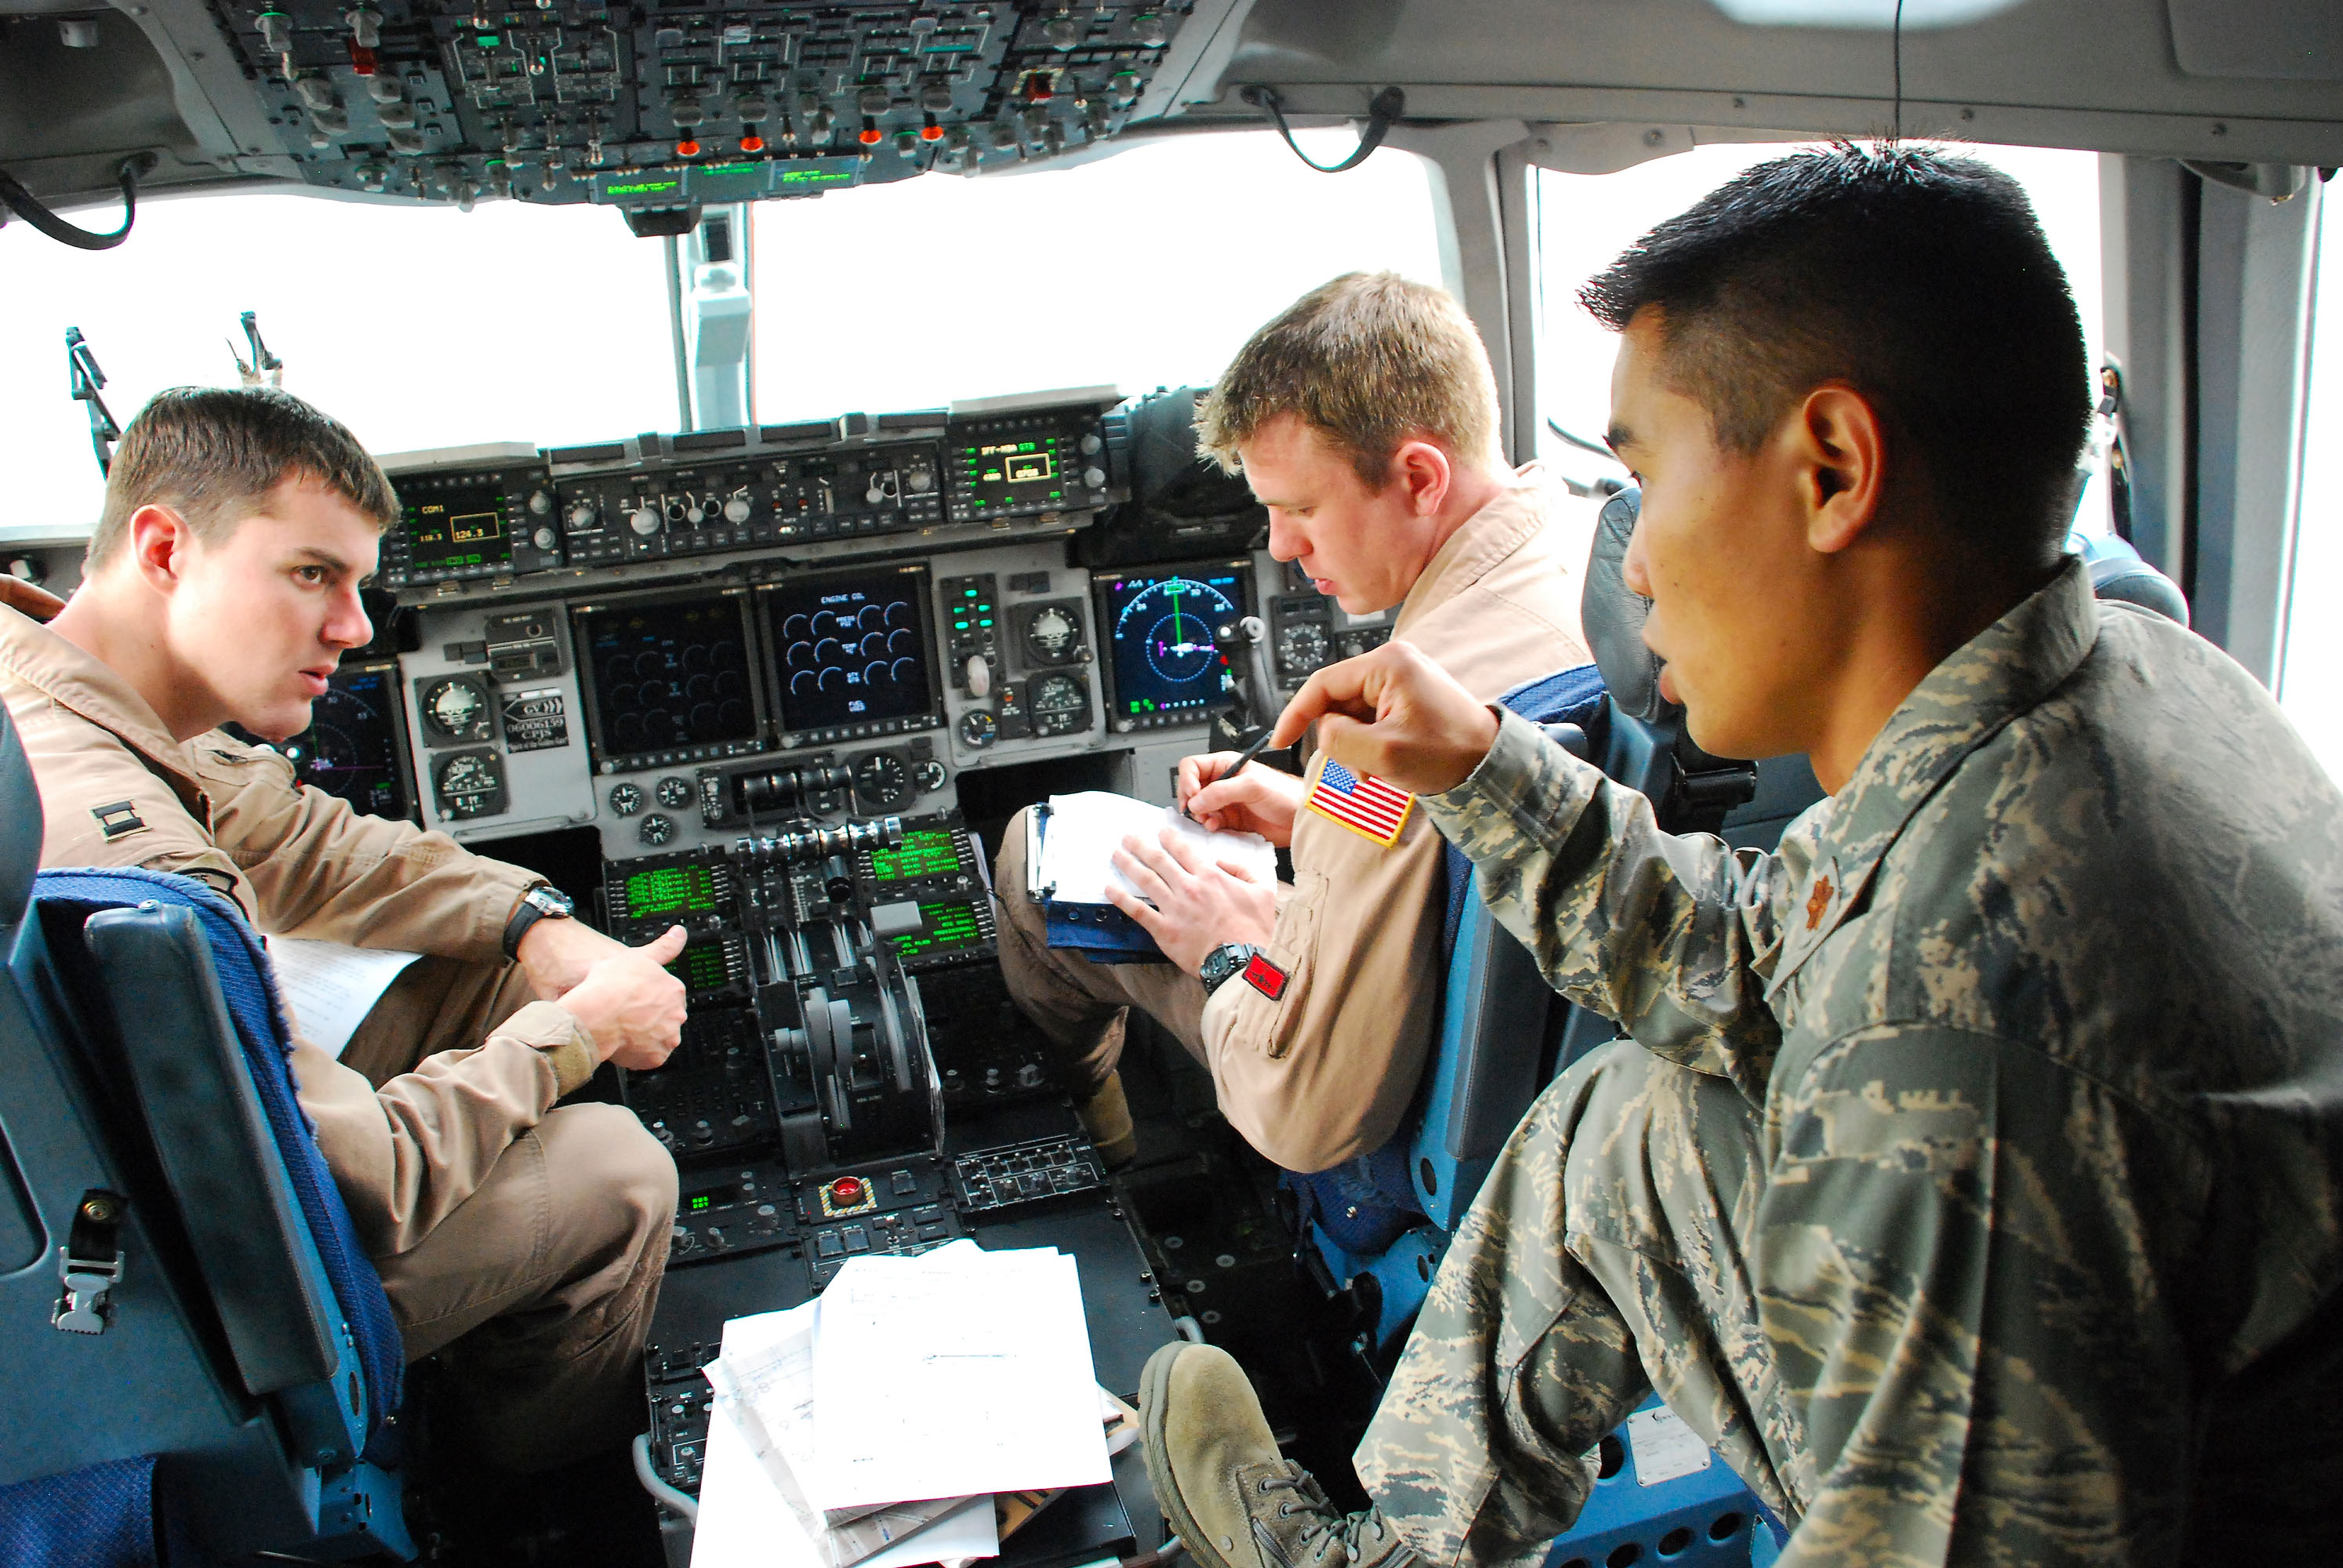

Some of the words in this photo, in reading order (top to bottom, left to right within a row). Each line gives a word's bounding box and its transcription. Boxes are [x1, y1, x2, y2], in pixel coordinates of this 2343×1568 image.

[422, 505, 444, 514] COM1
[821, 593, 849, 604] ENGINE
[852, 592, 866, 601] OIL
